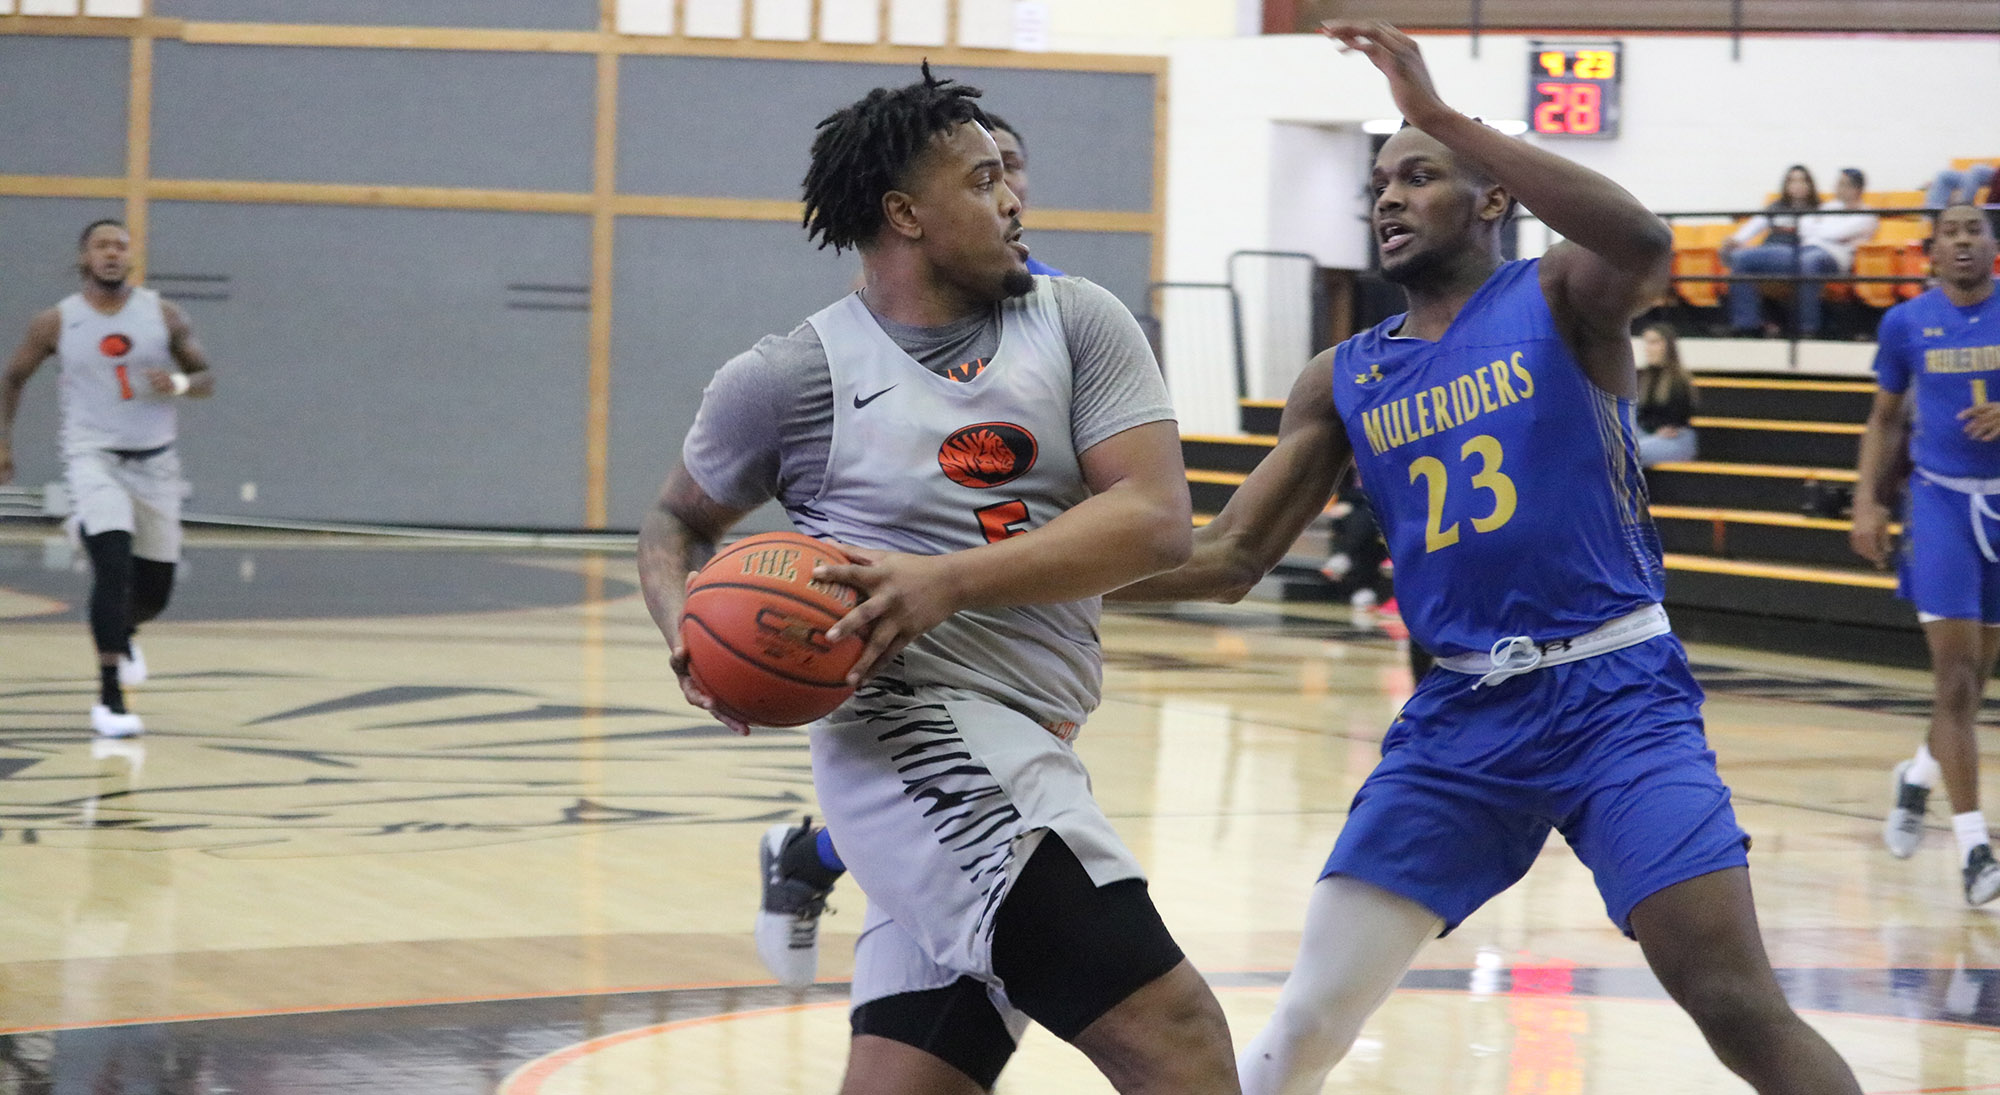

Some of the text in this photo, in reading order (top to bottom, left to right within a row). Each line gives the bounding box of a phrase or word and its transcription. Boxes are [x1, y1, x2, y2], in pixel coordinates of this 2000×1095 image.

[1534, 82, 1601, 134] 28
[1361, 351, 1535, 457] MULERIDERS
[1408, 434, 1518, 554] 23
[740, 549, 801, 584] THE
